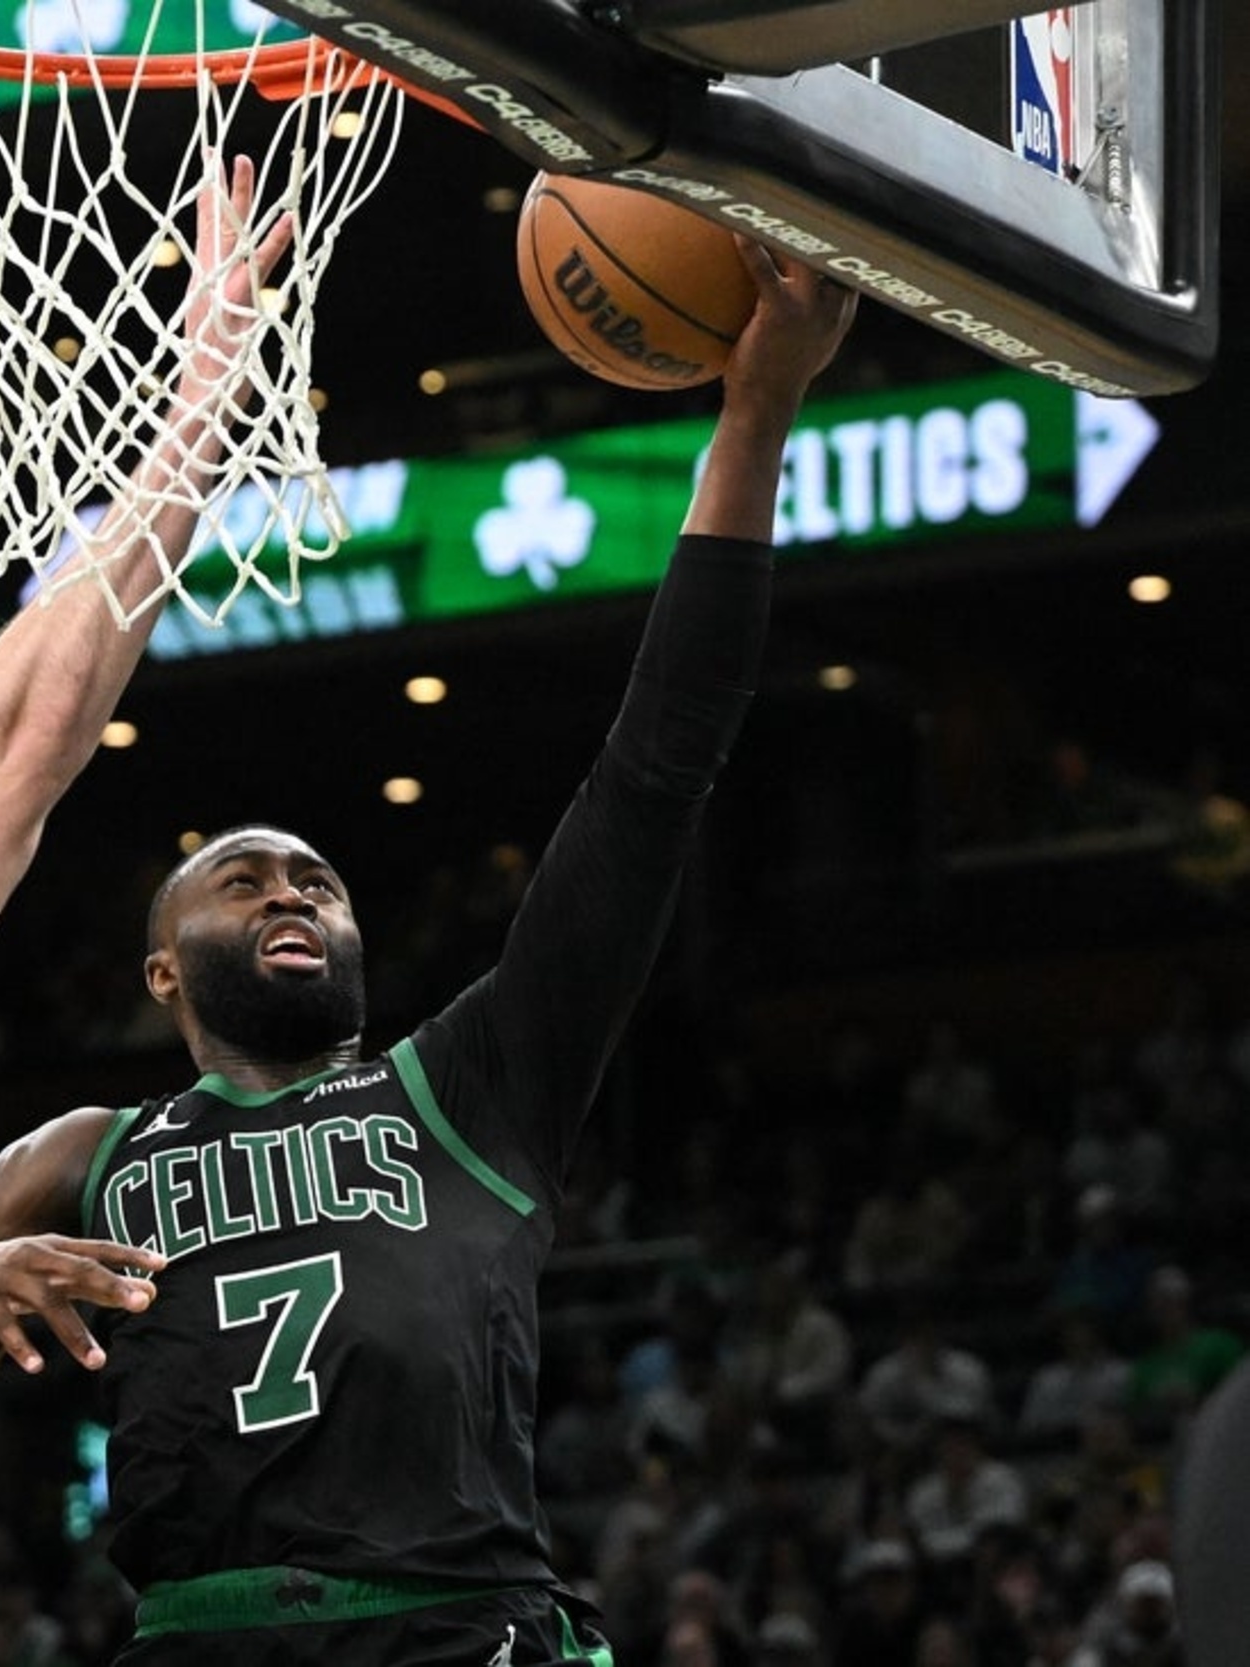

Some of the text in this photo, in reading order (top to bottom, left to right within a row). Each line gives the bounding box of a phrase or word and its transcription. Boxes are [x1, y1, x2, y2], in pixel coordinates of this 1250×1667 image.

[1019, 99, 1052, 160] NBA
[303, 1070, 389, 1104] Amica
[104, 1113, 428, 1281] CELTICS
[215, 1250, 344, 1434] 7
